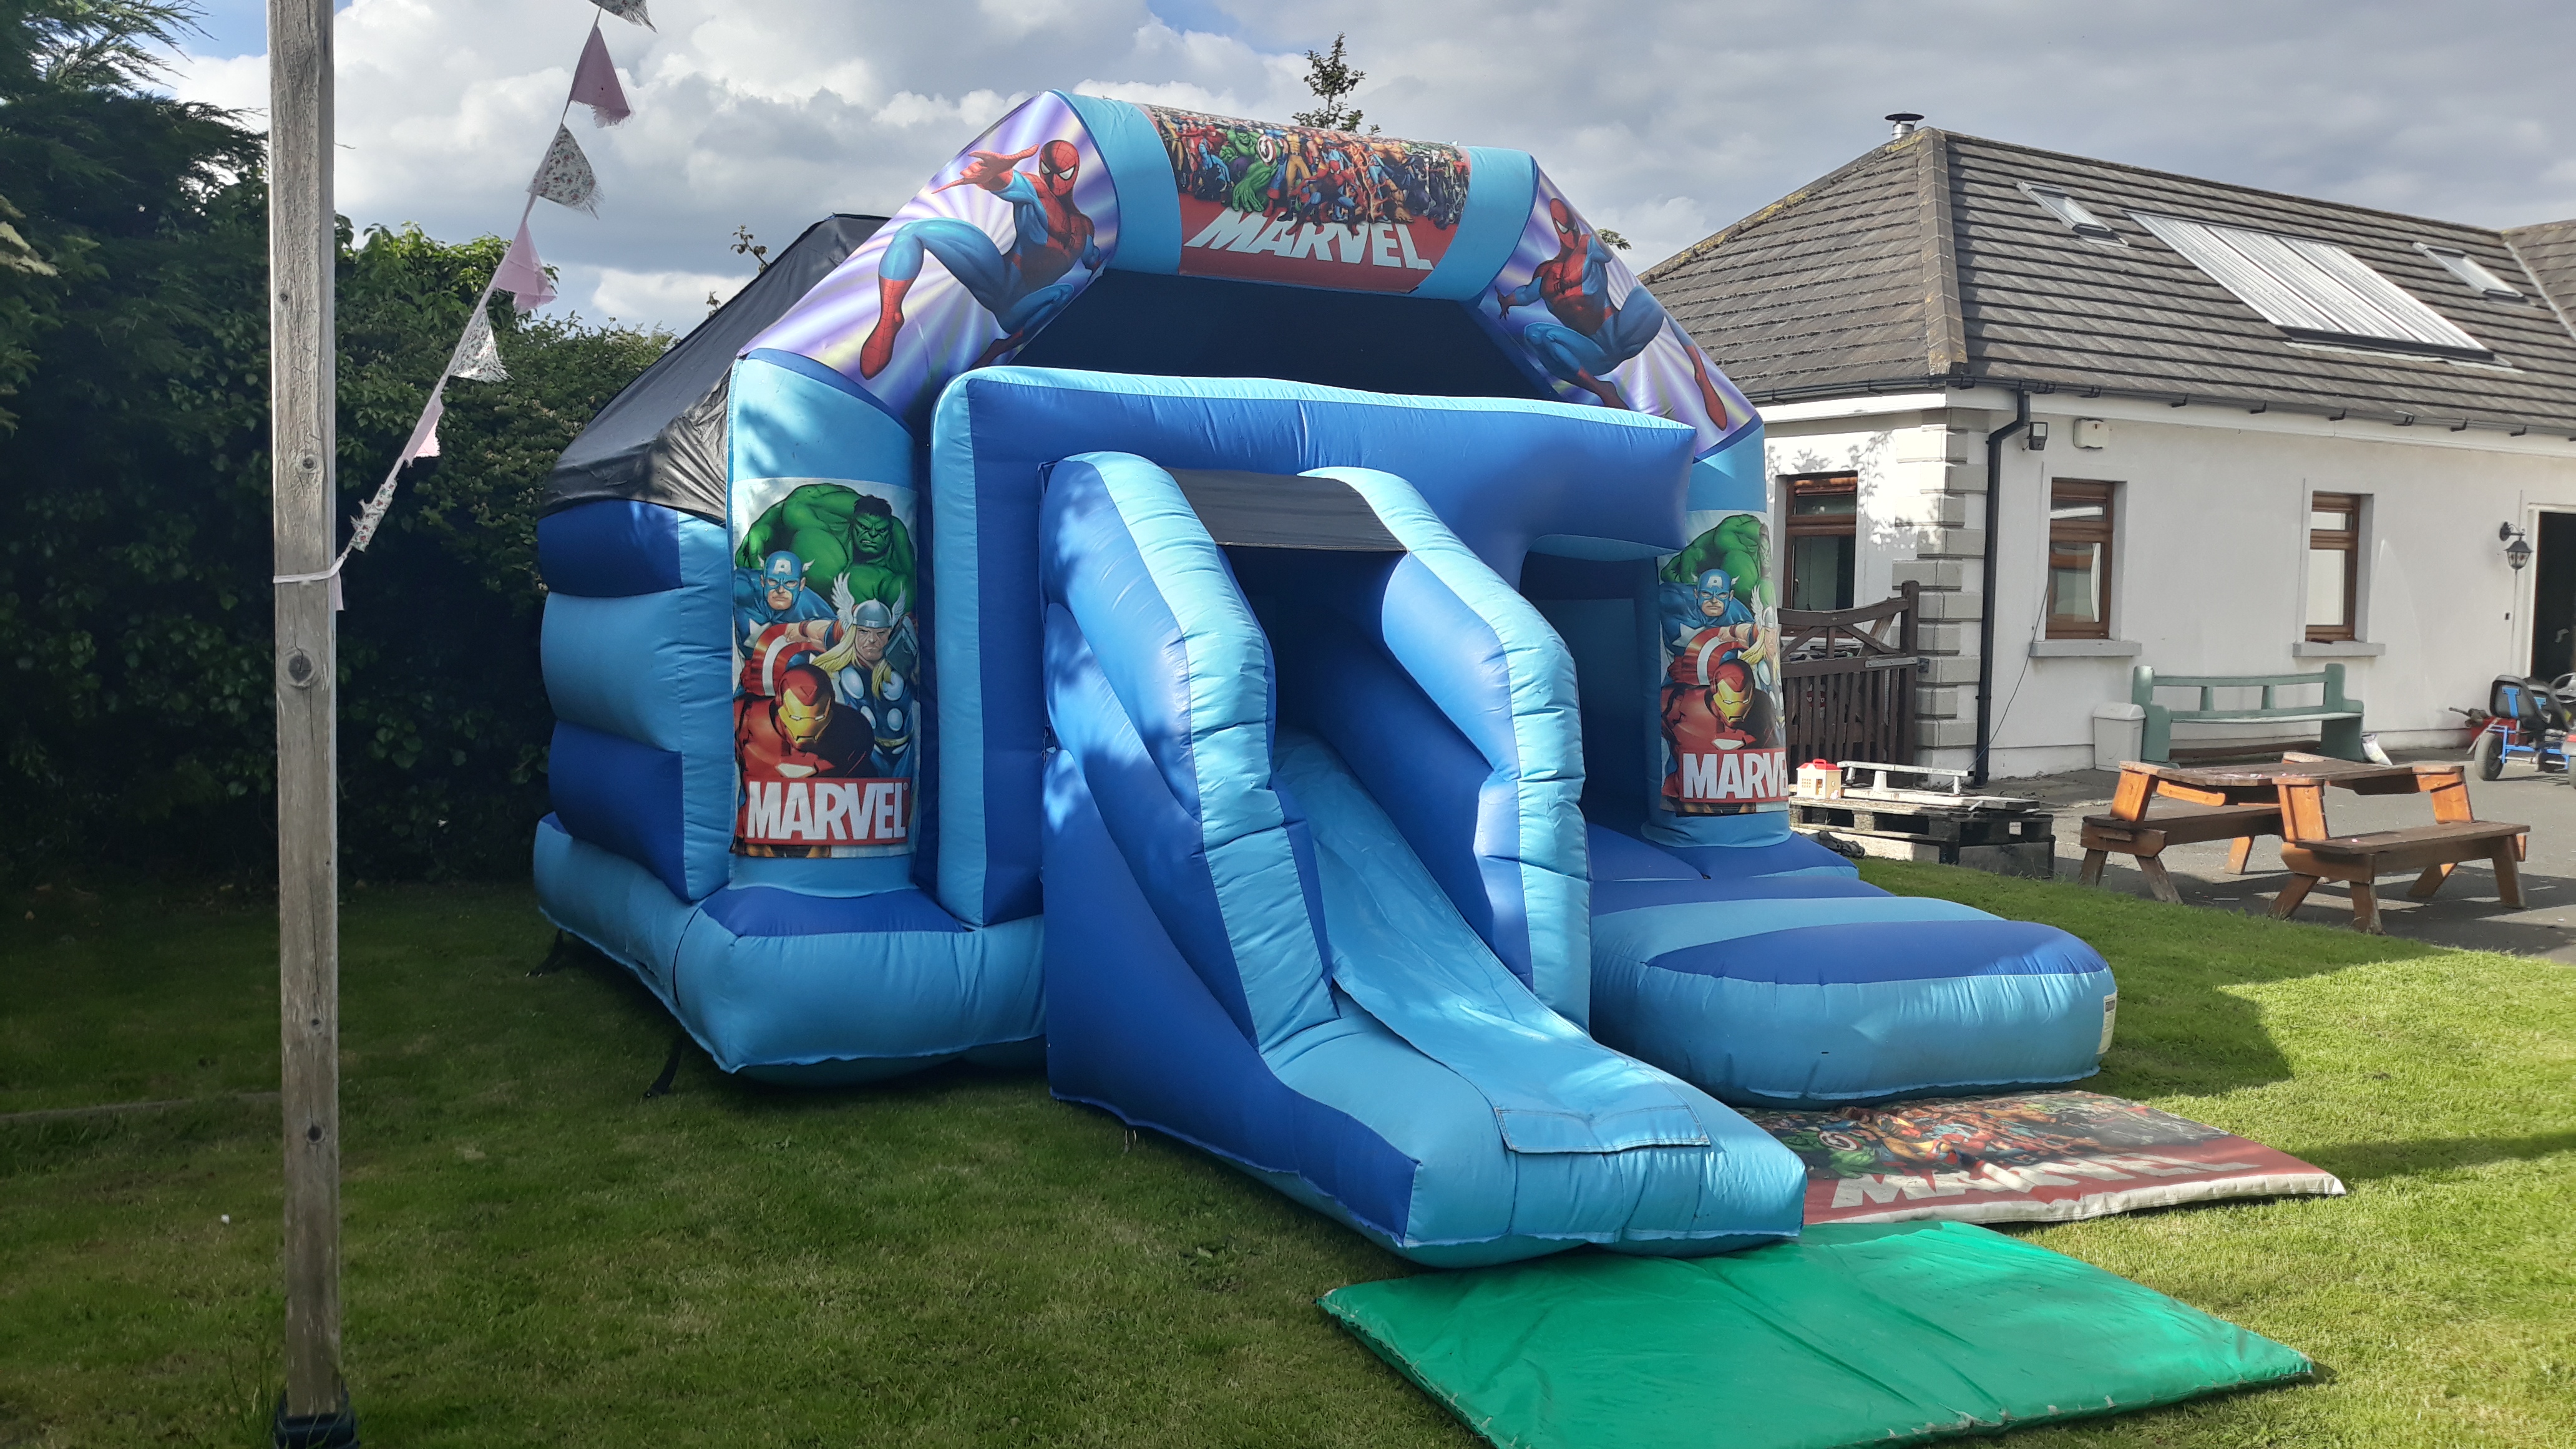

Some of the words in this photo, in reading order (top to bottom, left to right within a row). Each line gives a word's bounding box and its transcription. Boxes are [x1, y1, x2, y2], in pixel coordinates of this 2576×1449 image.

[1184, 207, 1434, 270] MARVEL
[1683, 751, 1789, 799] MARVE
[747, 781, 906, 840] MARVEL
